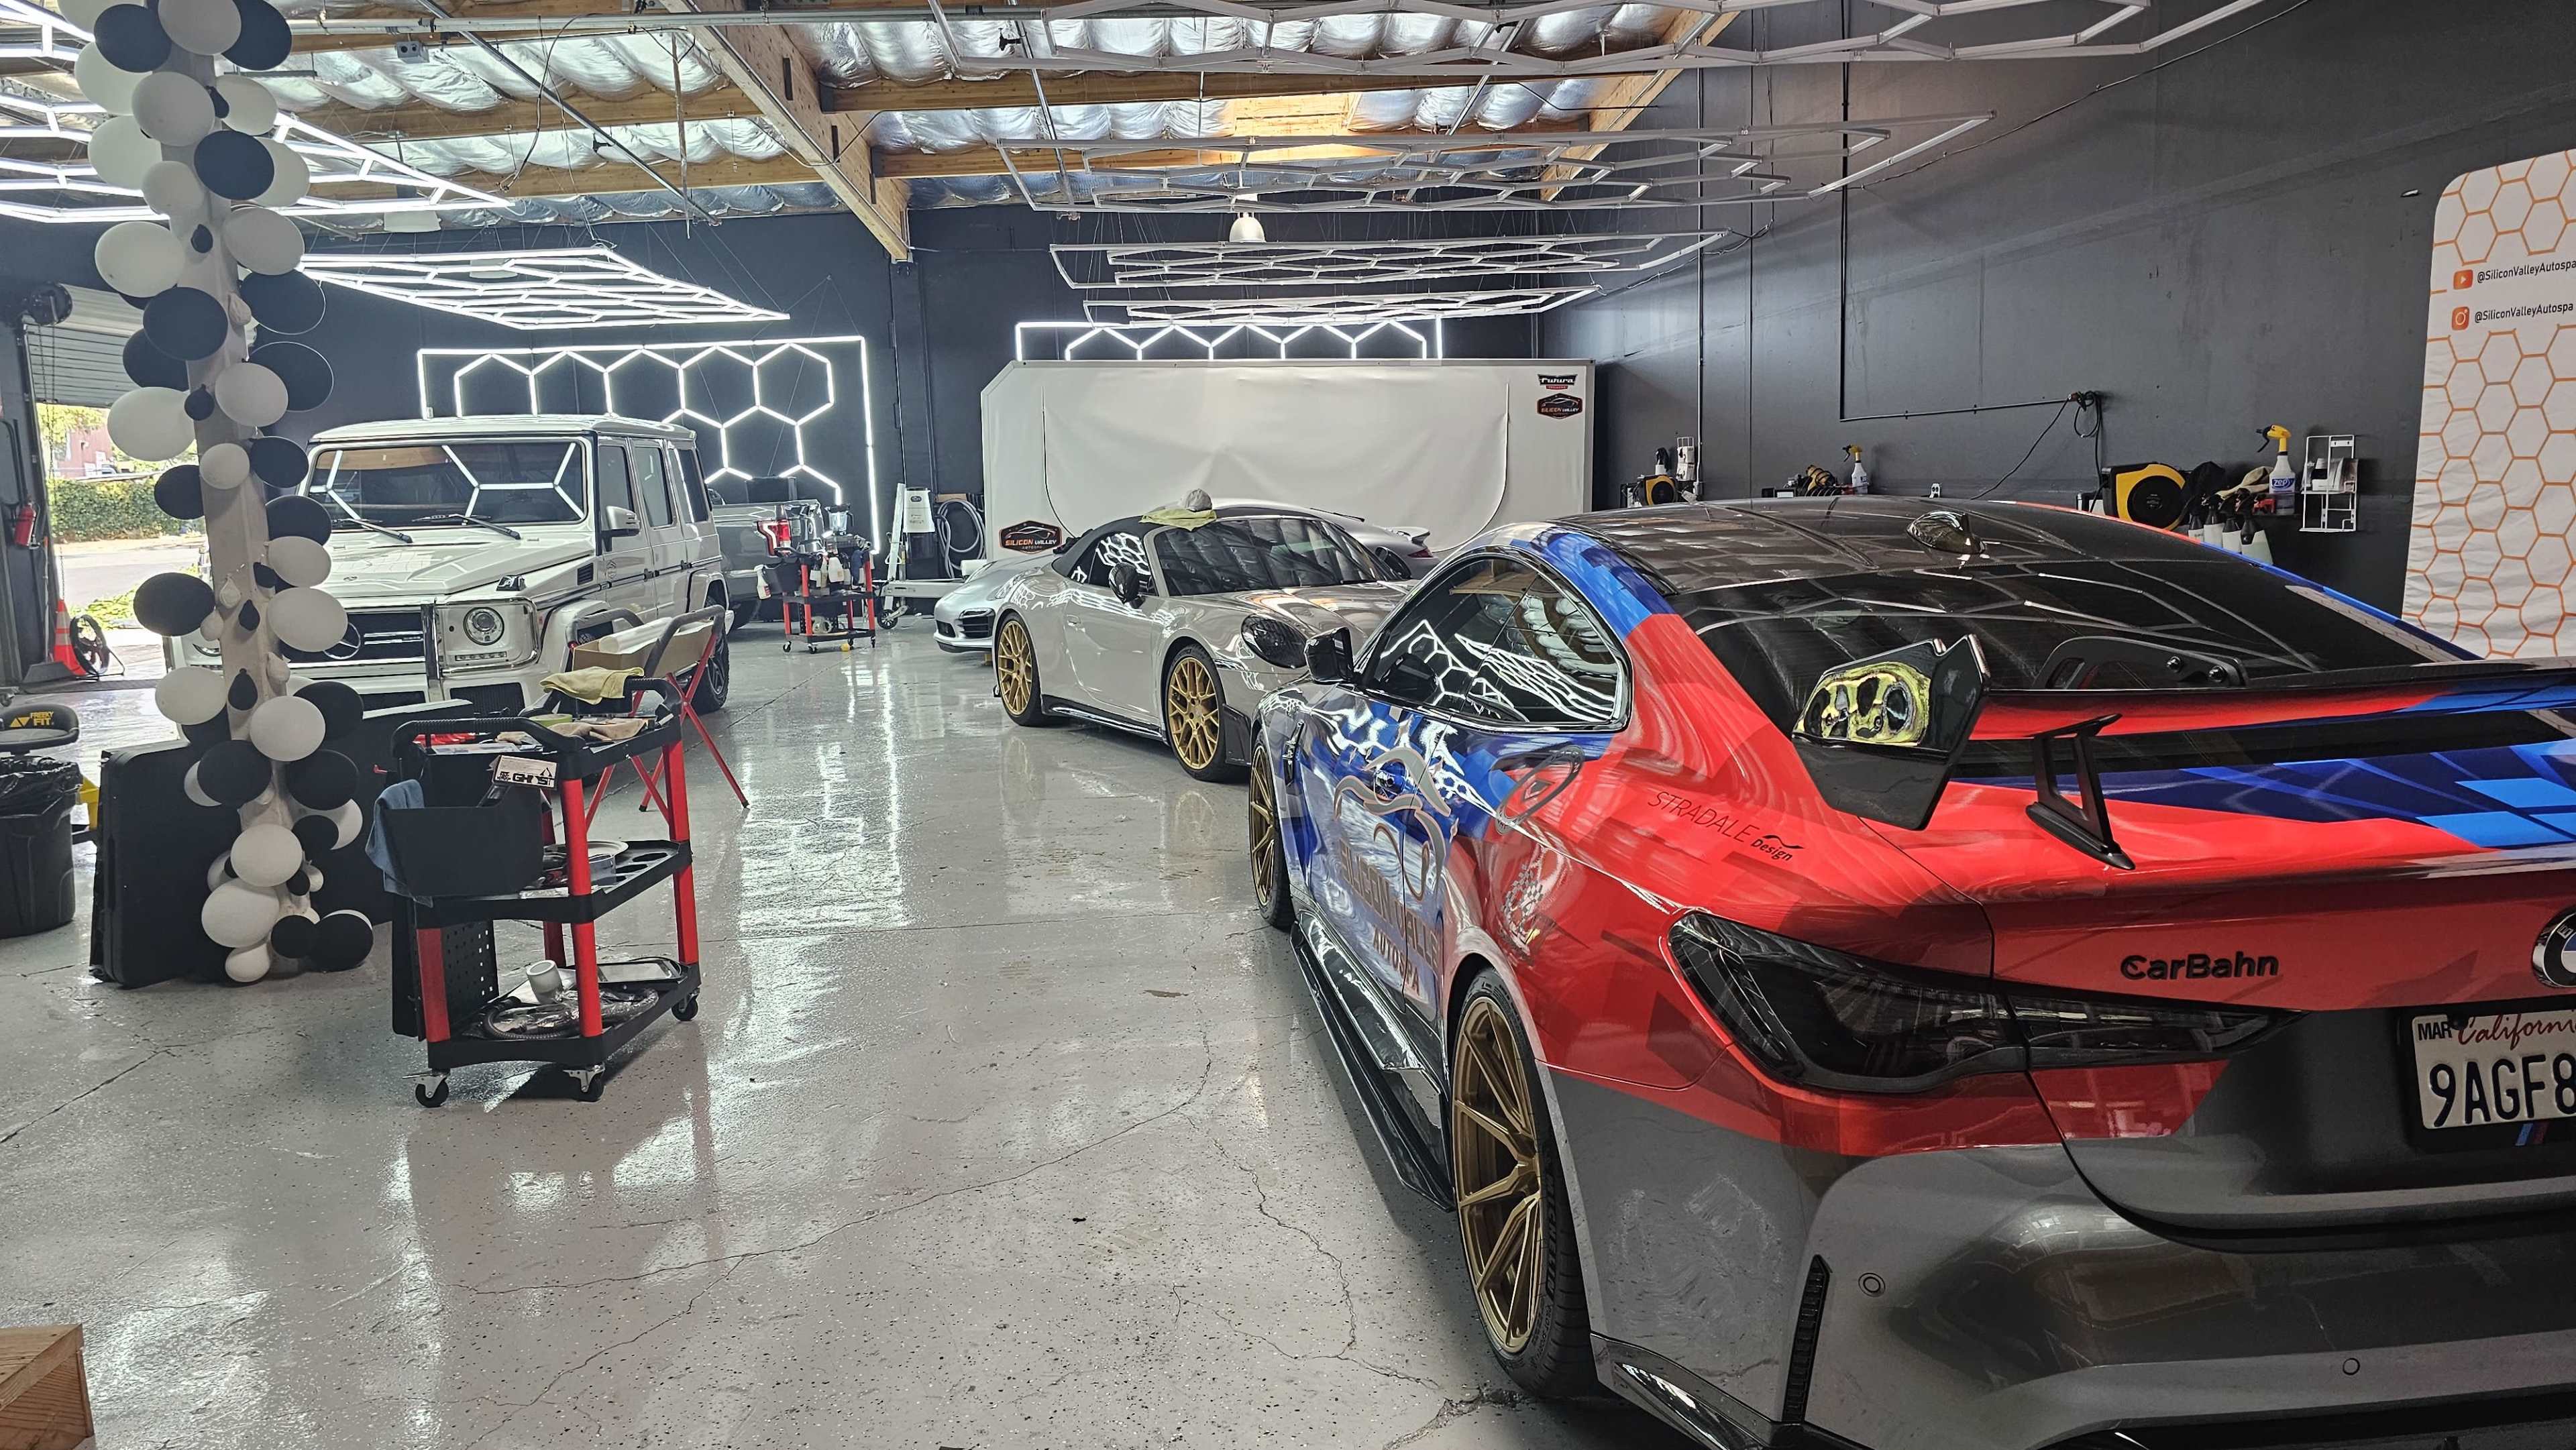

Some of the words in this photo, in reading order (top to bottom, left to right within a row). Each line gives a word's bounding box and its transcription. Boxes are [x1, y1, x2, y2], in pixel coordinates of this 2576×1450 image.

[2477, 260, 2576, 284] @SiliconValleyAutospa
[2474, 302, 2574, 323] @SiliconValleyAutospa
[34, 718, 52, 726] FIT
[512, 773, 555, 786] GHOST
[1647, 791, 1760, 843] STRADALE
[1750, 838, 1793, 862] Design
[1338, 838, 1393, 928] SILICON
[1393, 896, 1442, 976] VALLE
[1373, 927, 1421, 997] AUTOSPA
[2120, 950, 2279, 981] CarBahn
[2417, 1021, 2453, 1040] MAR
[2458, 1009, 2576, 1051] Californi
[2428, 1052, 2576, 1127] 9AGF8
